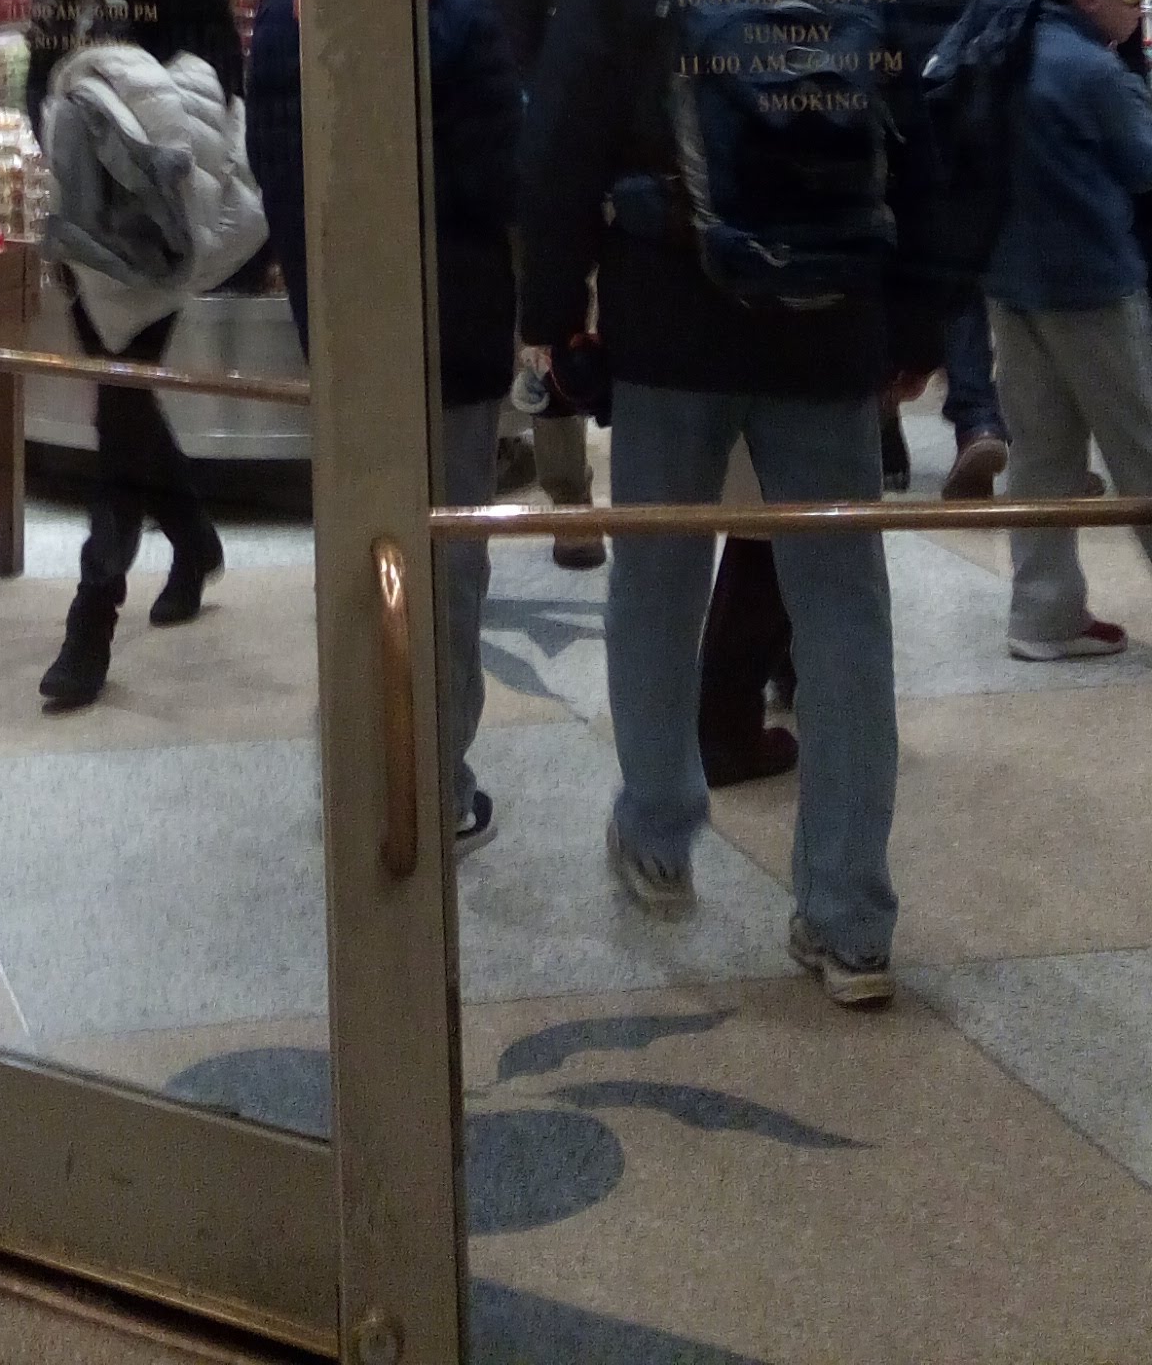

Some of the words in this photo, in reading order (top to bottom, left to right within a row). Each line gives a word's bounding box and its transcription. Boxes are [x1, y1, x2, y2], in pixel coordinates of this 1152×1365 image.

[133, 2, 159, 22] PM
[743, 23, 832, 44] SUNDAY
[749, 54, 787, 74] AM
[868, 51, 903, 72] PM
[758, 92, 869, 113] SMOKING
